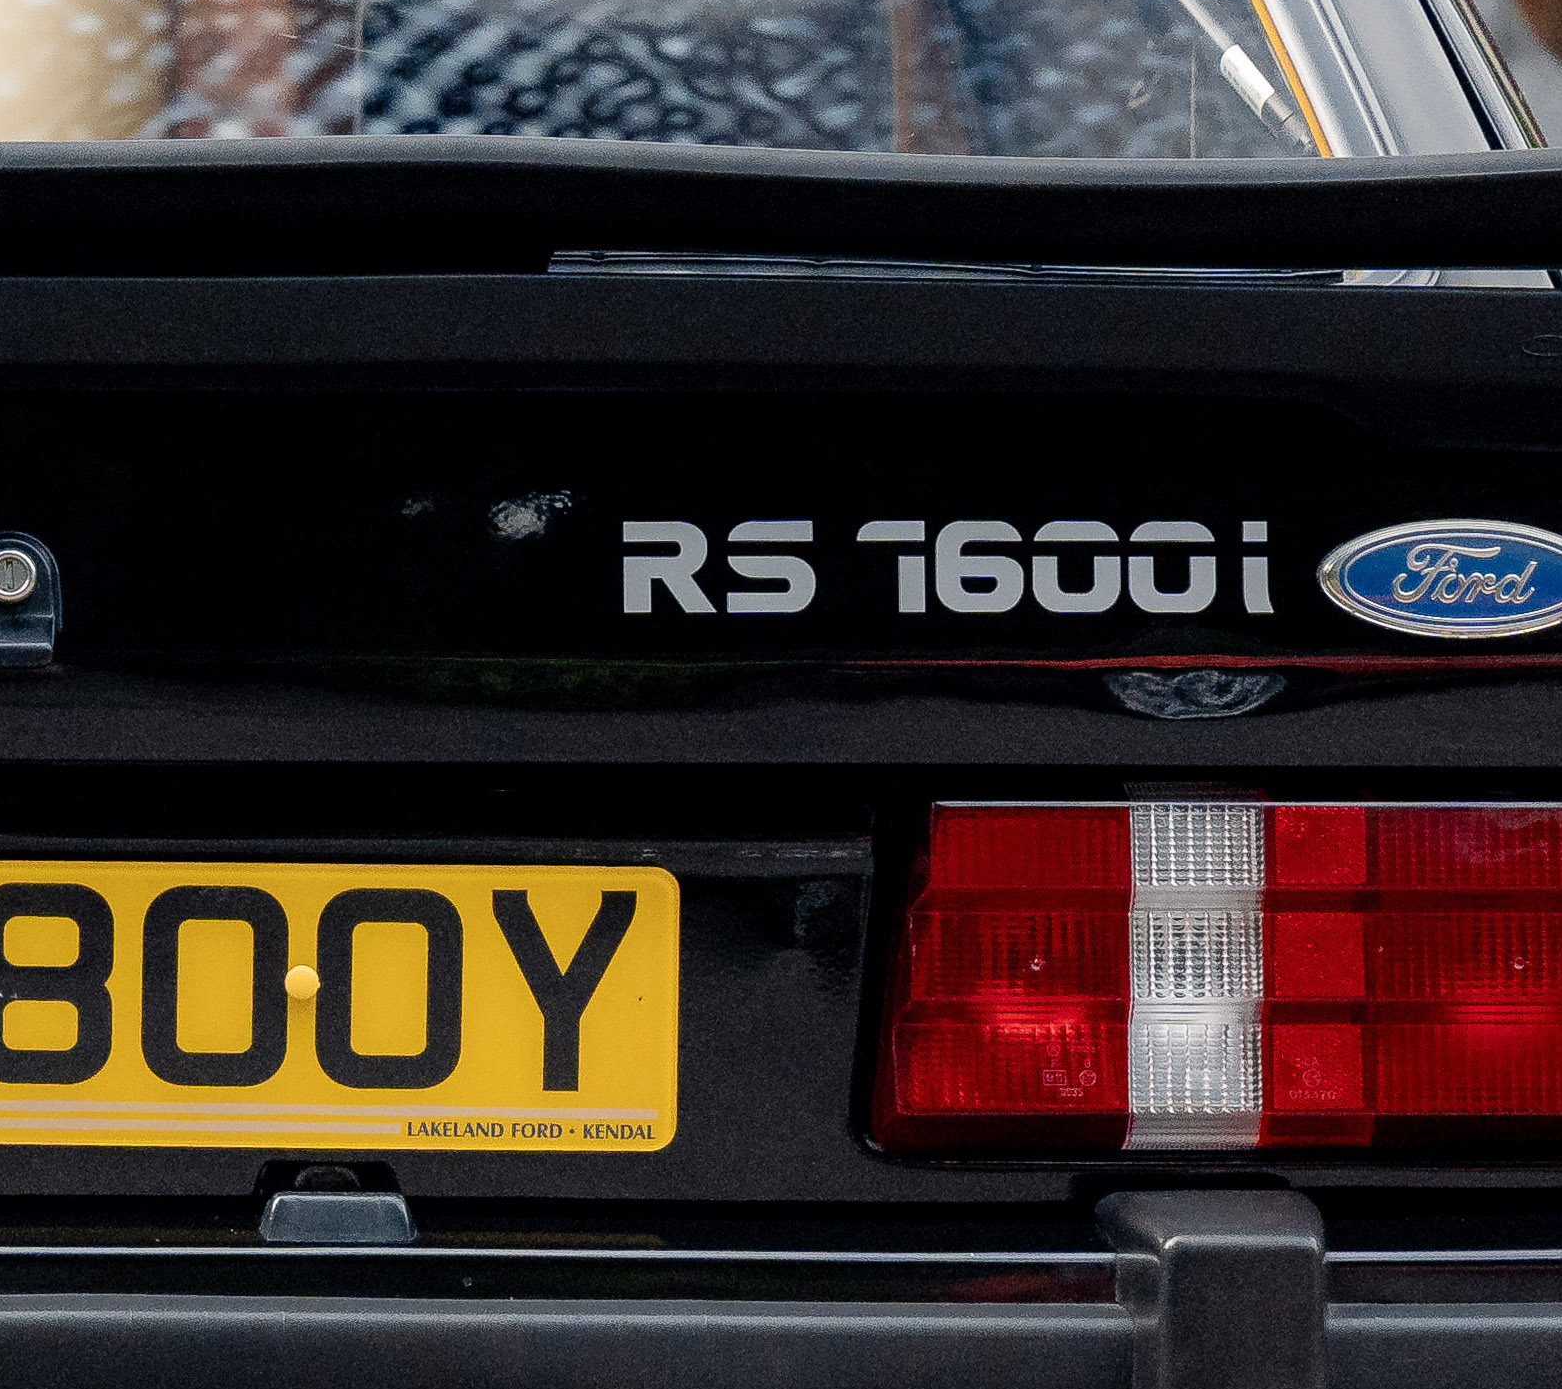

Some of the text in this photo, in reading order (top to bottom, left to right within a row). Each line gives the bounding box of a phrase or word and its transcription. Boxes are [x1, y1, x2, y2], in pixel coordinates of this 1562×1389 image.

[623, 520, 1273, 613] RS 1600i
[1392, 543, 1538, 604] Ford
[407, 1121, 656, 1140] LAKELAND FORD KENDAL
